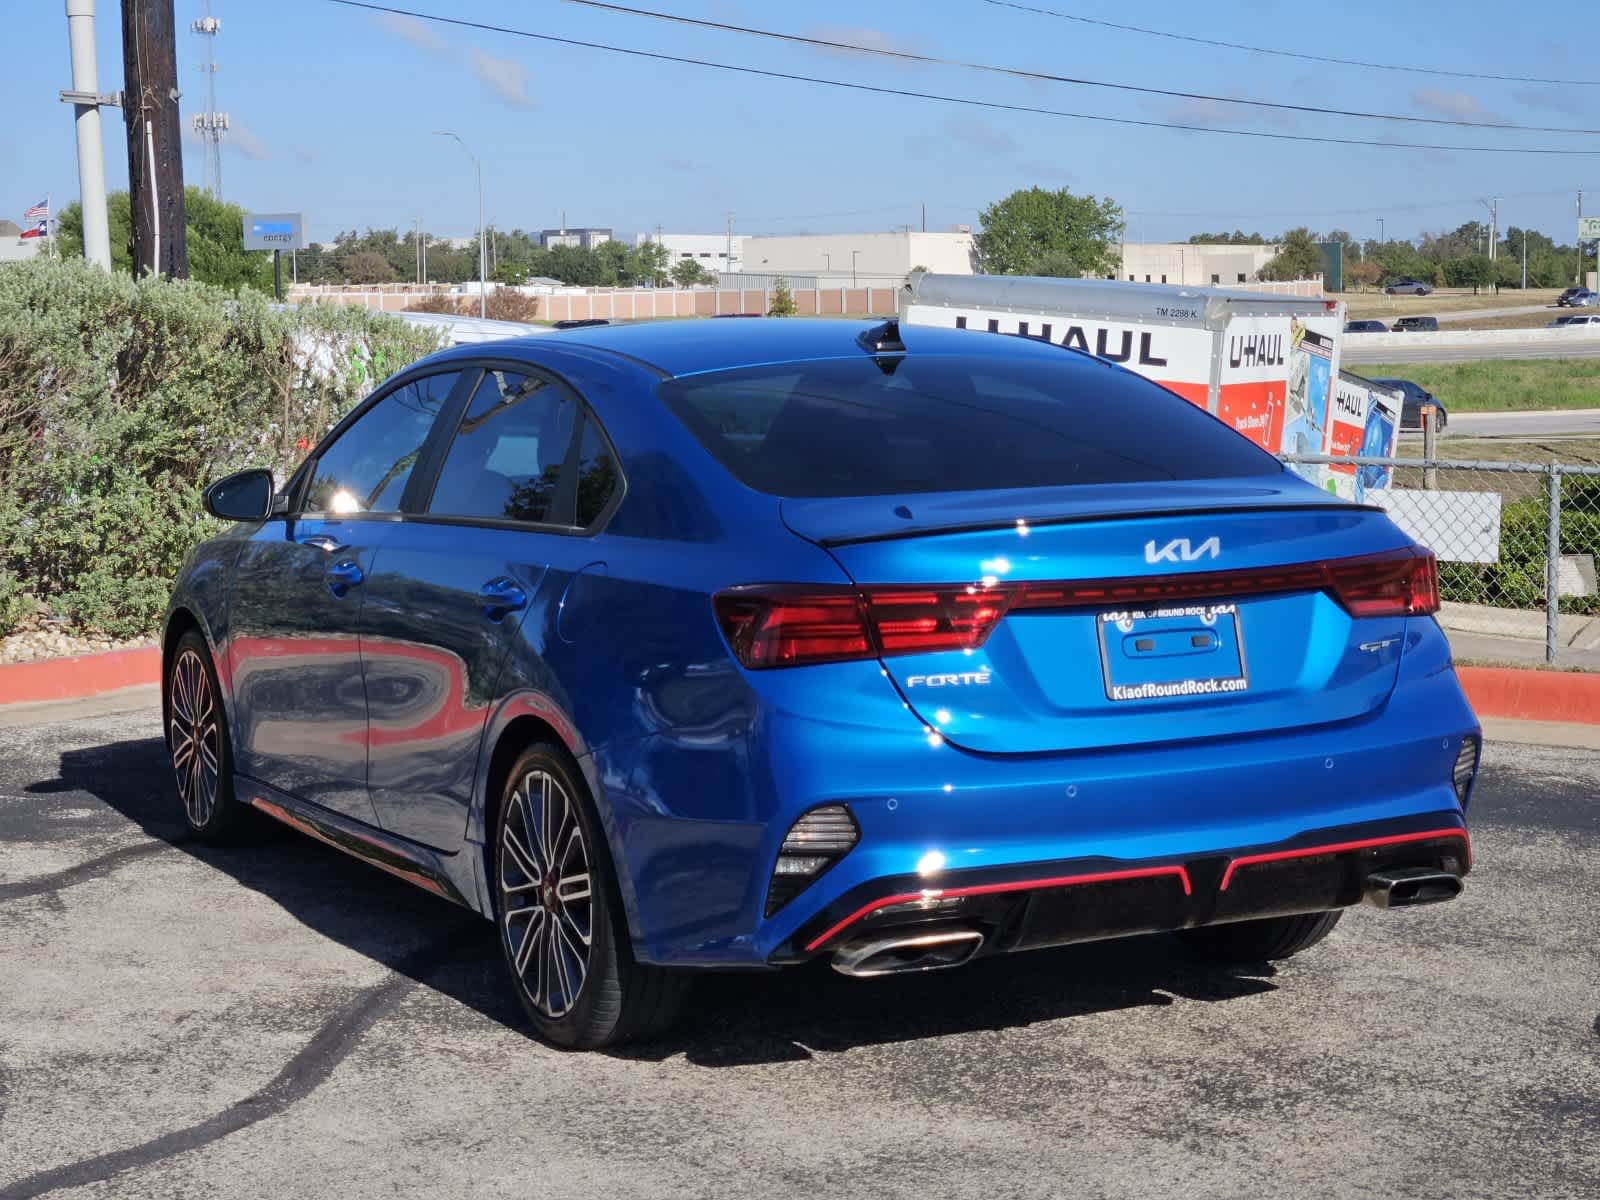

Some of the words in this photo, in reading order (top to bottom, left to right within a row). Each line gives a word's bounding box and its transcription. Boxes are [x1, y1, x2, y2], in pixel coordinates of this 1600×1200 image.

[1156, 307, 1169, 317] TM
[1229, 333, 1285, 369] U-HAUL
[1144, 536, 1221, 565] KIA
[1158, 607, 1185, 618] ROUND
[1185, 605, 1207, 616] ROCK
[907, 671, 992, 688] FORTE
[1112, 677, 1248, 701] KiaofRoundRock.com
